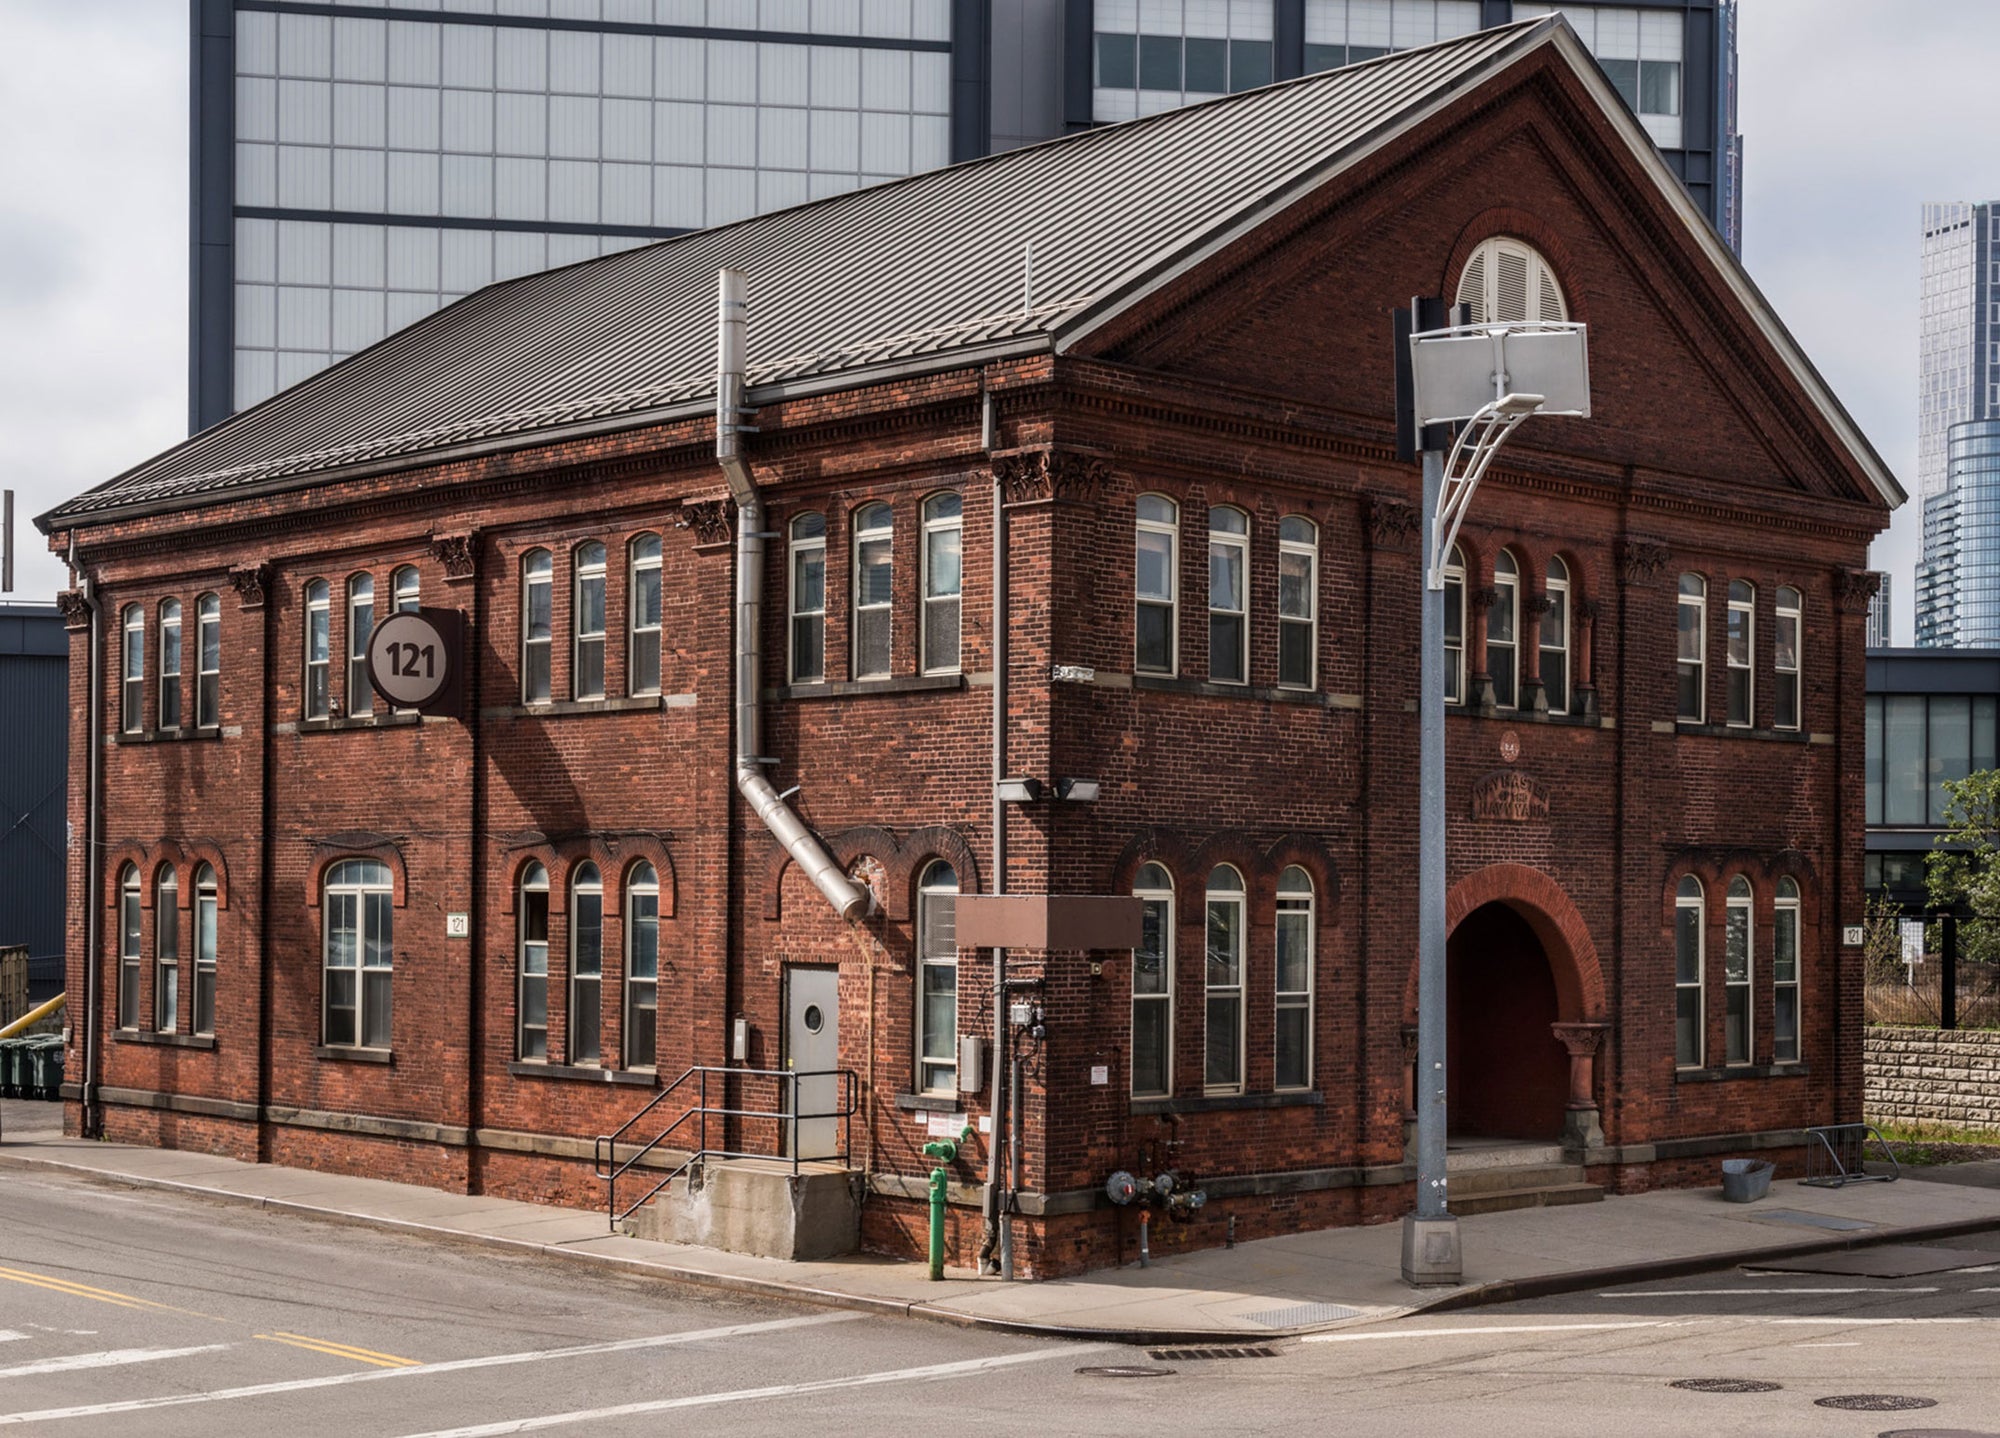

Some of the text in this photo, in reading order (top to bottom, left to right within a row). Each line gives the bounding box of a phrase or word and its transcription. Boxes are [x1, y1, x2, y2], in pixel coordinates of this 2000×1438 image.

[385, 642, 434, 678] 121
[1479, 802, 1547, 818] NAVY YARD
[452, 917, 464, 932] 121
[1848, 929, 1859, 943] 121
